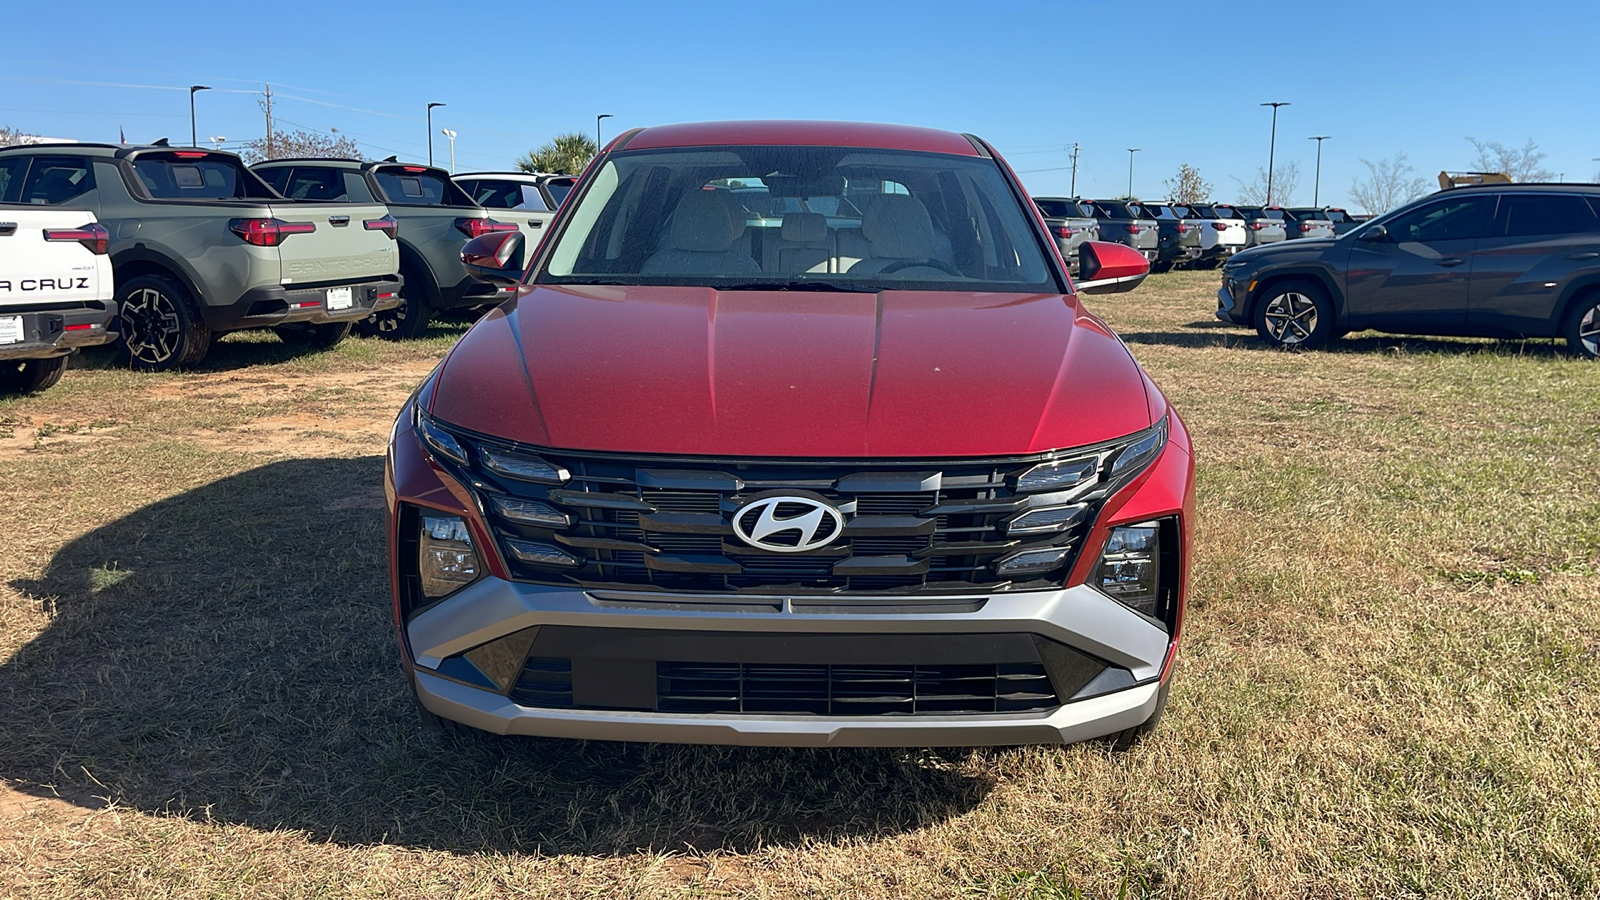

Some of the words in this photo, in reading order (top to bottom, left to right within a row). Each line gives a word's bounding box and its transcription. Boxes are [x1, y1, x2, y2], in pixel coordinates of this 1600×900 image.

[289, 258, 349, 274] SANTA
[352, 255, 390, 270] CRUZ
[20, 277, 90, 291] CRUZ
